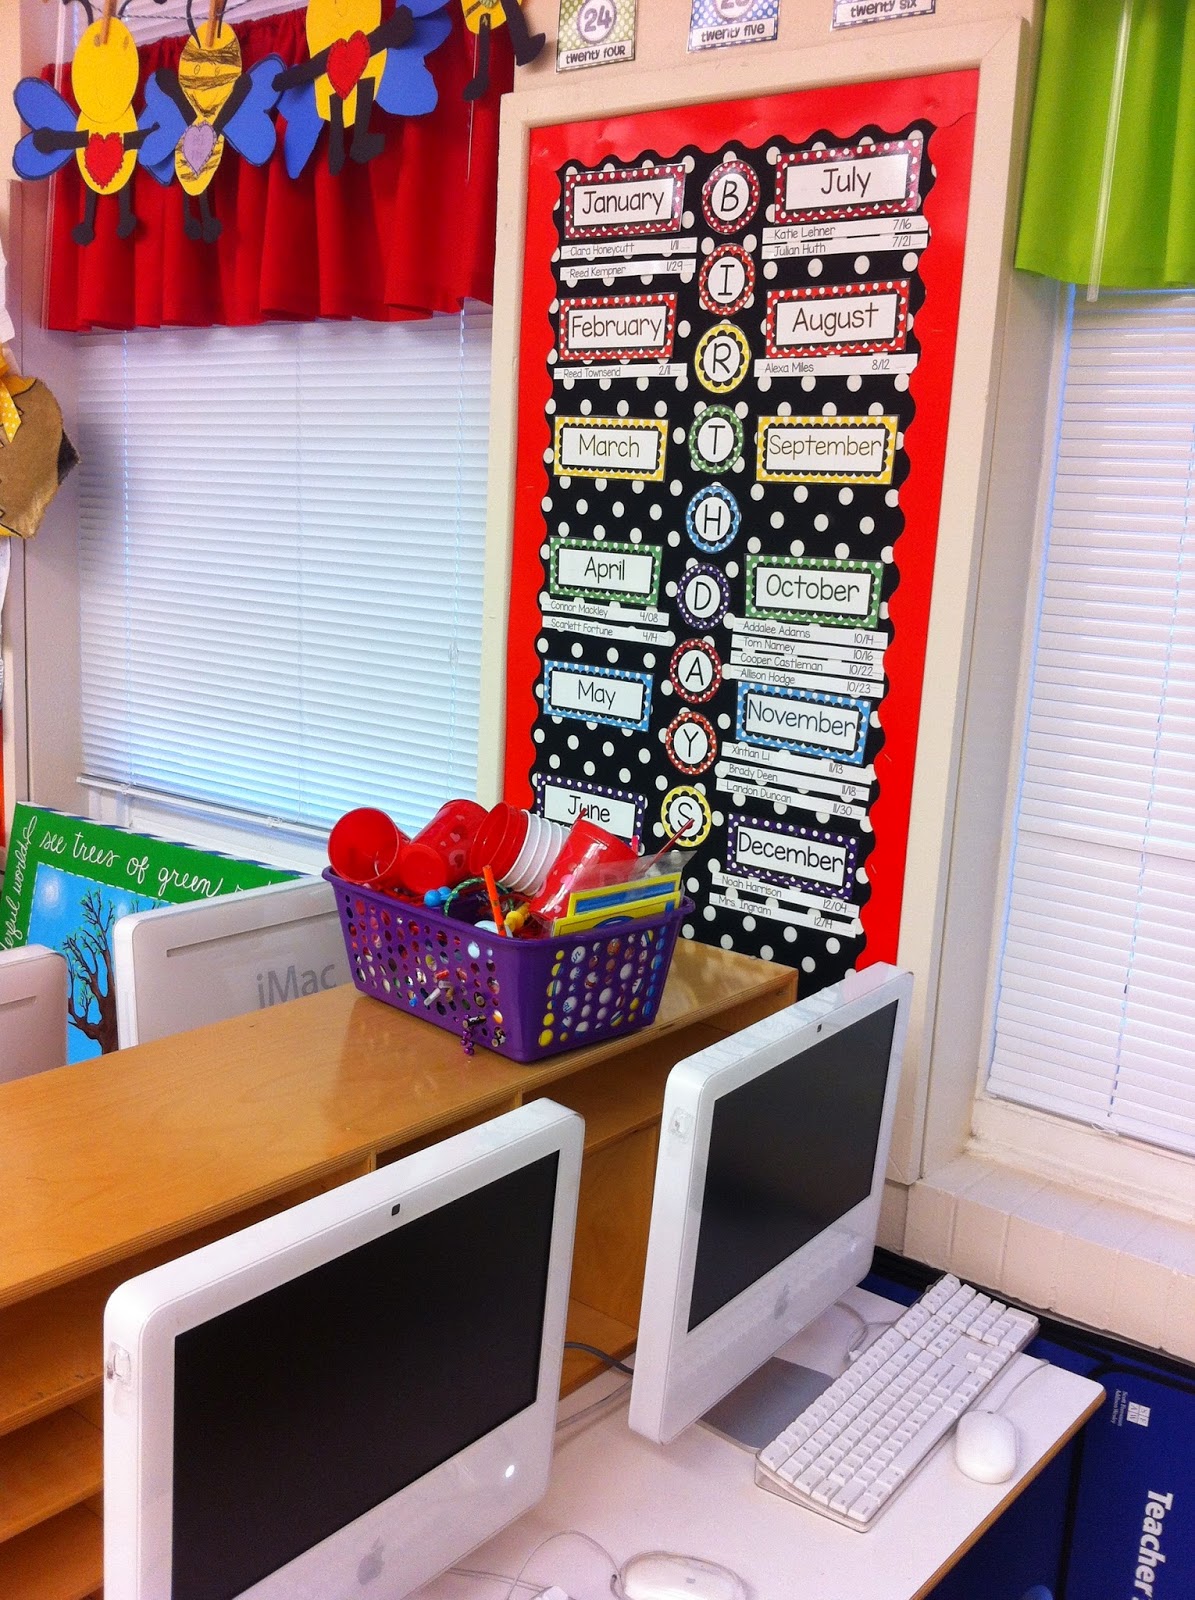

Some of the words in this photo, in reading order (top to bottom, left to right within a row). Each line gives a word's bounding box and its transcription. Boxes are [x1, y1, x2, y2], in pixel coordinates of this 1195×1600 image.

[584, 5, 613, 33] 24
[851, 0, 895, 18] twenty
[701, 27, 740, 42] twenty
[566, 49, 601, 65] twenty
[821, 166, 871, 198] July
[582, 190, 665, 216] January
[720, 180, 739, 212] B
[774, 228, 799, 239] Katie
[801, 226, 836, 238] Lehner
[892, 219, 912, 230] 7/16
[570, 246, 591, 257] Clara
[593, 243, 635, 255] Honeycutt
[773, 245, 800, 257] Julian
[802, 243, 826, 254] Huth
[892, 235, 911, 247] 7/21
[569, 268, 589, 278] Reed
[591, 265, 626, 278] Kempner
[666, 261, 683, 271] 1/29
[718, 264, 735, 296] I
[572, 315, 662, 342] February
[792, 302, 879, 337] August
[712, 342, 731, 374] R
[764, 362, 790, 373] Alexa
[791, 362, 814, 373] Miles
[871, 359, 890, 370] 8/12
[563, 368, 582, 378] Reed
[584, 367, 621, 377] Townsend
[579, 434, 640, 458] March
[708, 425, 726, 455] T
[769, 434, 882, 460] September
[703, 503, 722, 536] H
[584, 556, 625, 584] April
[694, 581, 712, 611] D
[766, 574, 860, 603] October
[550, 600, 577, 612] Connor
[578, 604, 608, 619] Mackley
[640, 612, 658, 622] 4/08
[551, 618, 581, 629] Scarlett
[583, 624, 613, 637] Fortune
[743, 621, 776, 635] Addalee
[778, 626, 811, 639] Adams
[854, 633, 874, 645] 10/14
[744, 637, 762, 648] Tom
[764, 639, 796, 654] Namey
[853, 650, 874, 661] 10/16
[685, 656, 704, 686] A
[740, 653, 772, 667] Cooper
[774, 656, 823, 671] Castleman
[849, 665, 873, 677] 10/22
[578, 679, 616, 710] May
[740, 668, 767, 680] Allison
[768, 671, 796, 686] Hodge
[846, 681, 871, 694] 10/23
[748, 700, 856, 737] November
[683, 728, 699, 758] Y
[729, 764, 755, 779] Brady
[757, 770, 778, 782] Deen
[567, 795, 611, 823] June
[726, 781, 759, 798] Landon
[761, 788, 792, 804] Duncan
[833, 803, 853, 816] 11/30
[677, 802, 694, 829] S
[39, 831, 67, 854] see
[73, 831, 121, 868] trees
[126, 856, 150, 884] of
[158, 867, 224, 897] green
[739, 832, 844, 873] December
[722, 876, 744, 888] Noah
[746, 881, 782, 898] Harrison
[823, 901, 847, 914] 12/04
[739, 900, 772, 916] Ingram
[256, 964, 337, 1009] iMac
[1131, 1490, 1174, 1600] Teacher
